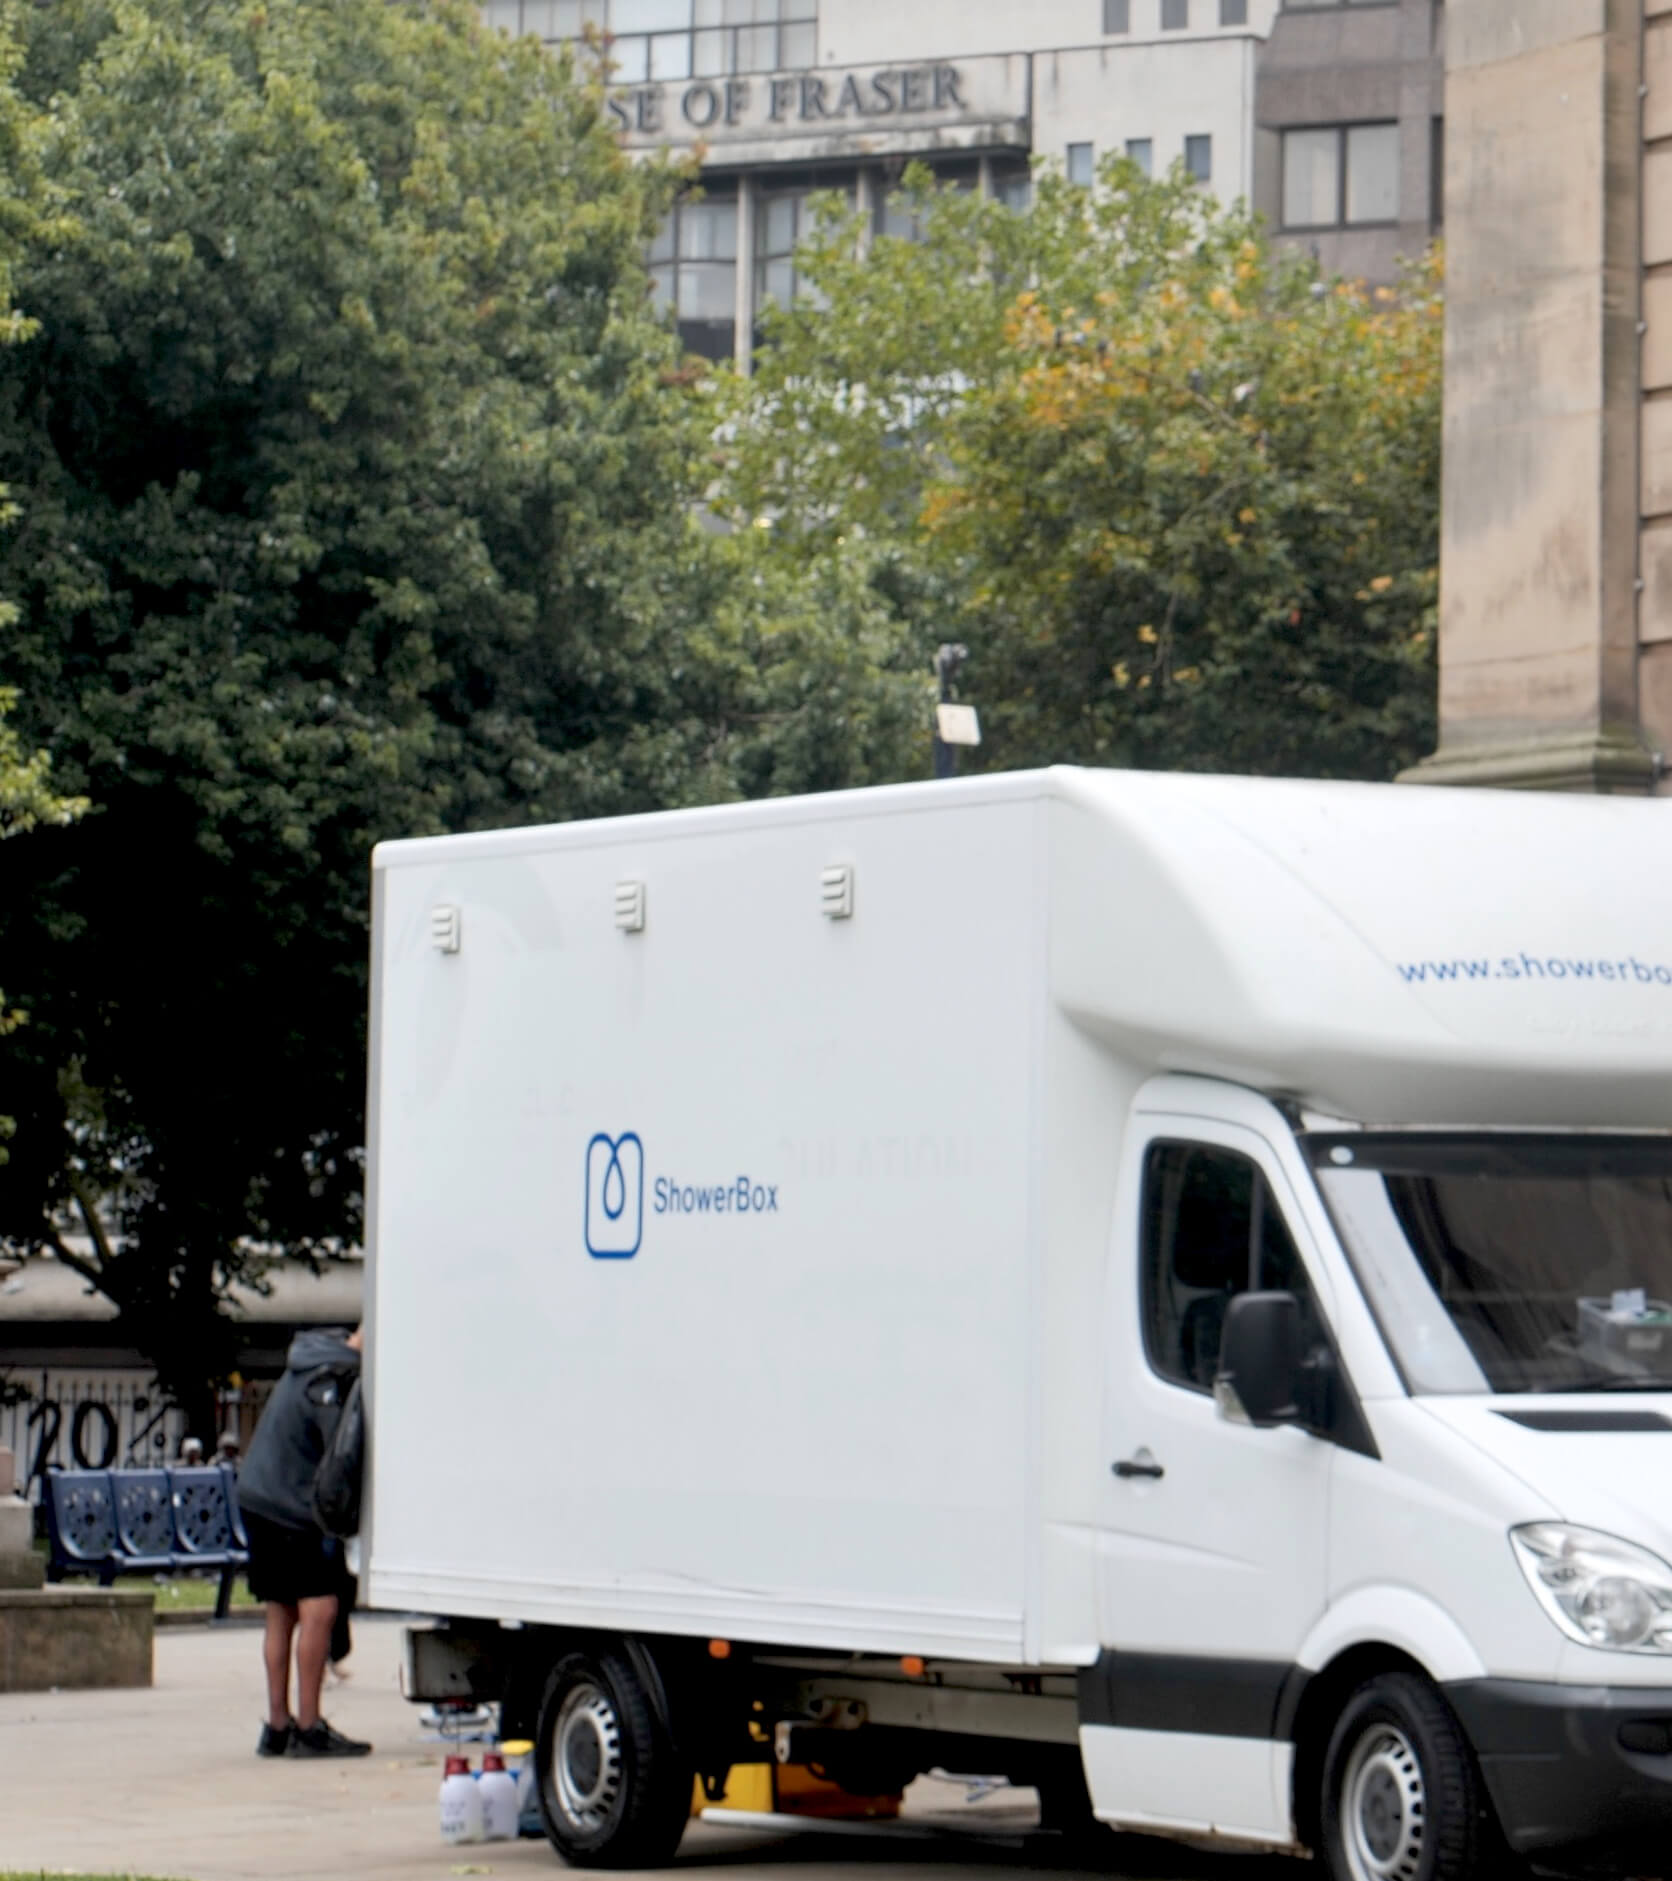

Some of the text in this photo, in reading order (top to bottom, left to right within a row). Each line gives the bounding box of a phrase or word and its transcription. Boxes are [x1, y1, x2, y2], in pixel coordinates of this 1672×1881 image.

[682, 80, 748, 128] OF
[769, 63, 969, 121] FRASER
[653, 1175, 779, 1214] ShowerBox
